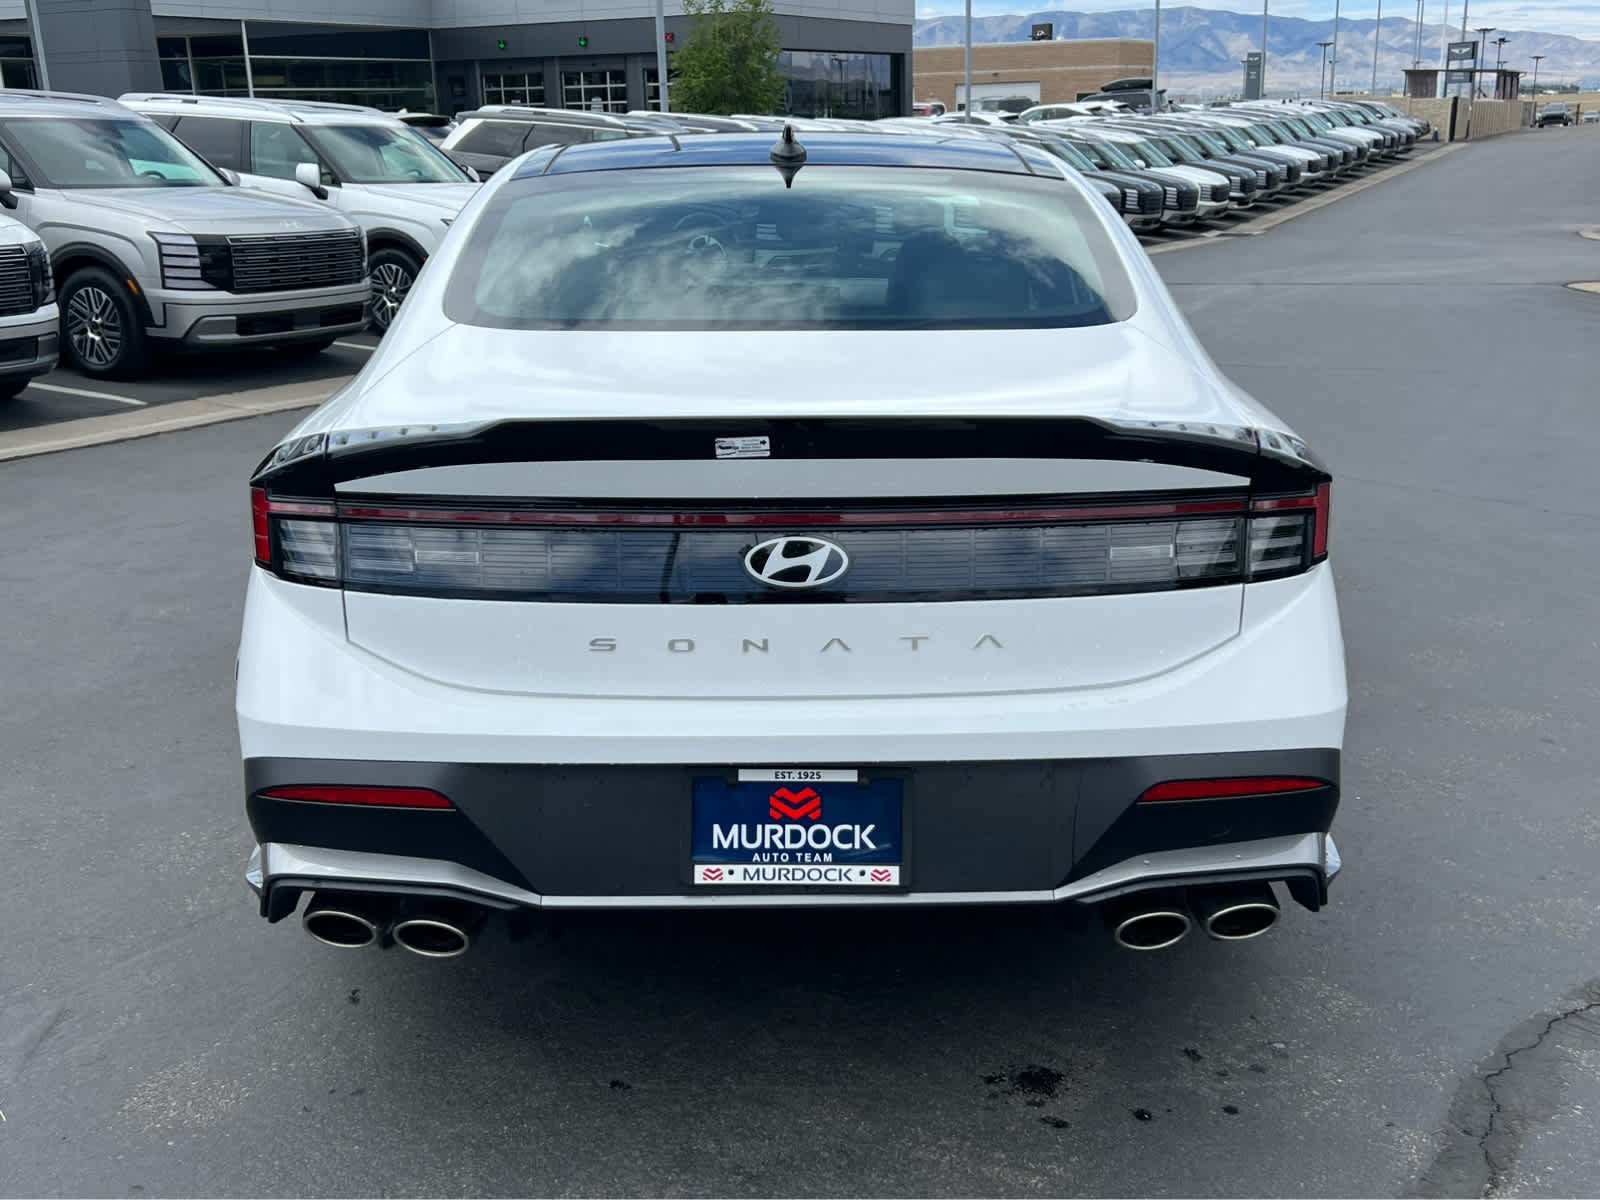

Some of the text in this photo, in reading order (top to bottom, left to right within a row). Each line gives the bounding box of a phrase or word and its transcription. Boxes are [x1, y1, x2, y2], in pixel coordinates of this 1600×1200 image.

[588, 633, 1004, 653] SONATA
[774, 770, 822, 780] EST. 1925
[712, 823, 877, 849] MURDOCK
[752, 853, 833, 863] AUTO TEAM
[743, 867, 853, 882] MURDOCK
